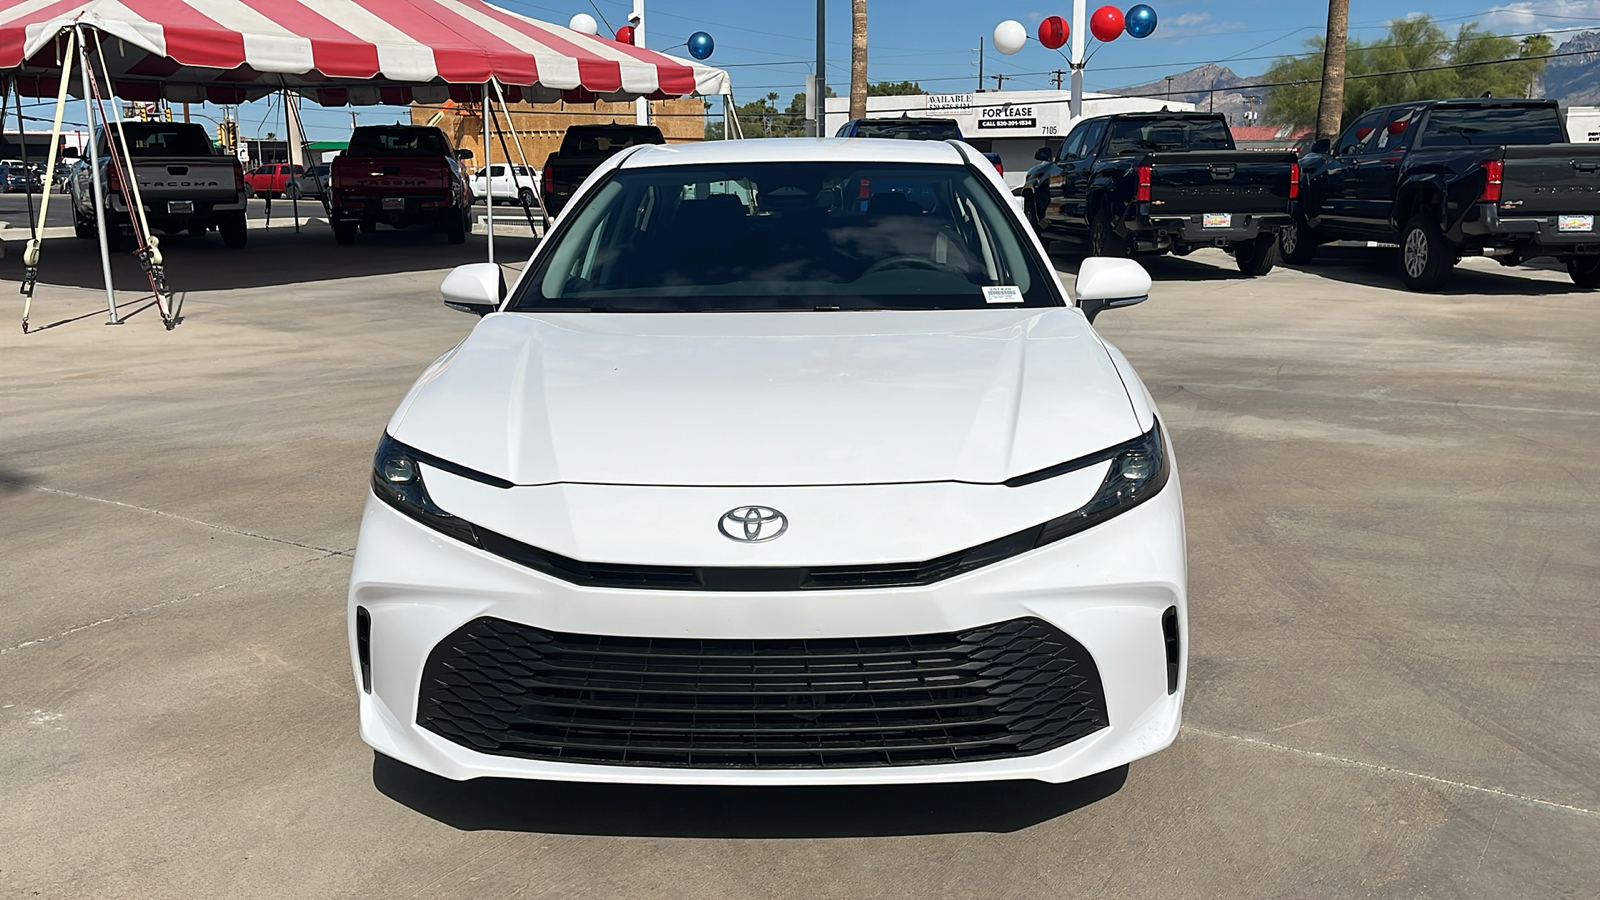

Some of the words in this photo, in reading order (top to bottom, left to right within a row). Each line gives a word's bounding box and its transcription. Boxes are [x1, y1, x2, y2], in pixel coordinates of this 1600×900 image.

[928, 95, 972, 104] AVAILABLE
[982, 109, 1002, 118] FOR
[1004, 107, 1033, 117] LEASE
[1042, 126, 1057, 135] 7105
